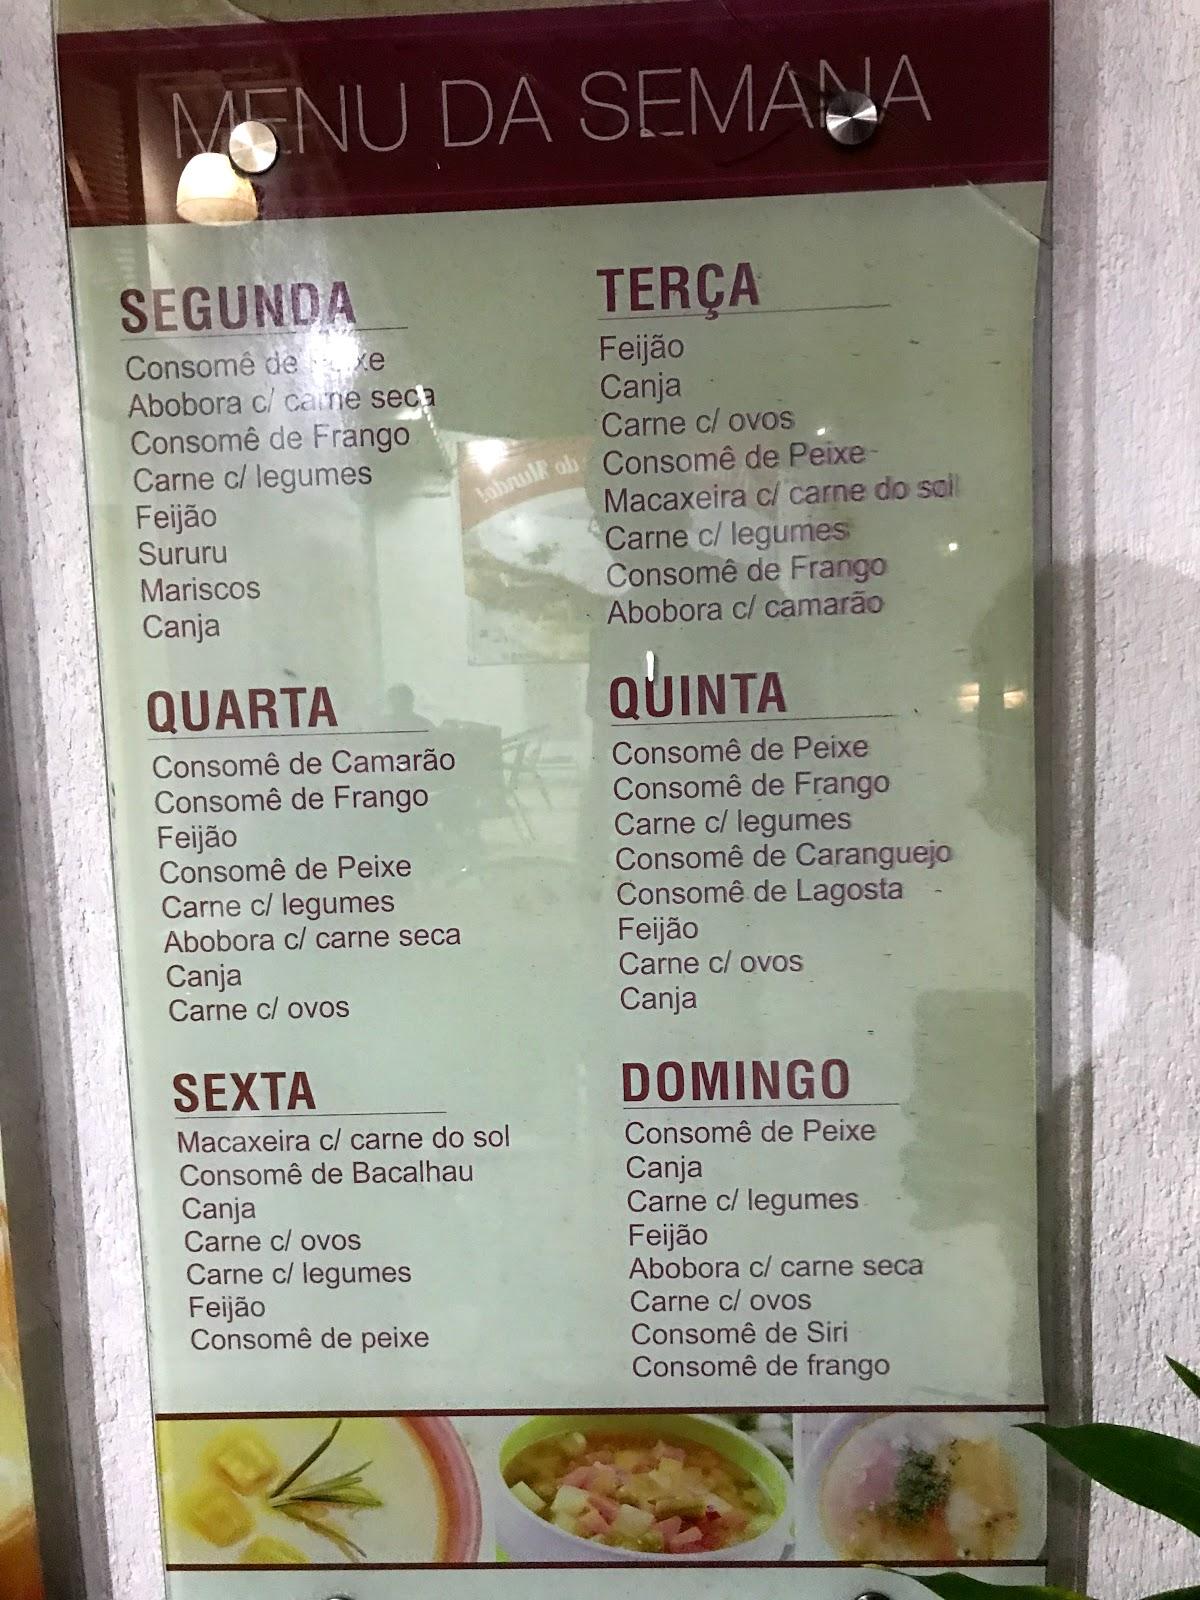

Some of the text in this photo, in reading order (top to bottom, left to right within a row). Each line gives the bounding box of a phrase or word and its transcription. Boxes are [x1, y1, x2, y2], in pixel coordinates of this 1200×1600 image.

[172, 54, 933, 159] MENU DA SEMANA
[596, 262, 759, 320] TERÇA
[120, 281, 356, 333] SEGUNDA
[601, 334, 684, 366] Feijão
[126, 352, 256, 381] Consomê
[264, 351, 298, 375] de
[128, 392, 241, 418] Abobora
[252, 387, 274, 413] c/
[371, 387, 436, 409] seca
[601, 372, 681, 404] Canja
[602, 408, 795, 438] Carne c/ ovos
[131, 424, 409, 455] Consomê de Frango
[603, 442, 865, 475] Consomê de Peixe
[134, 464, 372, 494] Carne c/ legumes
[605, 473, 955, 513] Macaxeira c/ carne do sol
[136, 504, 216, 534] Feijão
[606, 521, 850, 551] Carne c/ legumes
[139, 542, 227, 566] Sururu
[607, 555, 887, 587] Consomê de Frango
[141, 577, 260, 603] Mariscos
[607, 591, 885, 624] Abobora c/ camarão
[143, 613, 220, 643] Canja
[610, 671, 787, 720] QUINTA
[147, 687, 338, 734] QUARTA
[153, 748, 455, 779] Consomê de Camarão
[613, 735, 870, 765] Consomê de Peixe
[155, 785, 428, 814] Consomê de Frango
[614, 771, 890, 800] Consomê de Frango
[615, 809, 852, 838] Carne c/ legumes
[158, 825, 237, 854] Feijão
[160, 855, 411, 884] Consomê de Peixe
[616, 840, 953, 870] Consomê de Caranguejo
[162, 892, 394, 921] Carne c/ legumes
[617, 878, 904, 907] Consomê de Lagosta
[164, 926, 461, 953] Abobora c/ carne seca
[619, 917, 698, 945] Feijão
[620, 950, 803, 975] Carne c/ ovos
[166, 963, 242, 992] Canja
[169, 996, 349, 1022] Carne c/ ovos
[621, 986, 697, 1015] Canja
[173, 1071, 316, 1113] SEXTA
[622, 1059, 849, 1102] DOMINGO
[177, 1124, 509, 1153] Macaxeira c/ carne do sol
[625, 1119, 877, 1144] Consomê de Peixe
[180, 1160, 473, 1186] Consomê de Bacalhau
[627, 1155, 702, 1184] Canja
[182, 1197, 256, 1224] Canja
[627, 1188, 858, 1216] Carne c/ legumes
[185, 1229, 361, 1252] Carne c/ ovos
[629, 1223, 707, 1251] Feijão
[187, 1262, 411, 1289] Carne c/ legumes
[629, 1255, 924, 1279] Abobora c/ carne seca
[189, 1296, 265, 1323] Feijão
[631, 1289, 811, 1312] Carne c/ ovos
[191, 1326, 429, 1354] Consomê de peixe
[632, 1321, 847, 1345] Consomê de Siri
[633, 1354, 890, 1381] Consomê de frango
